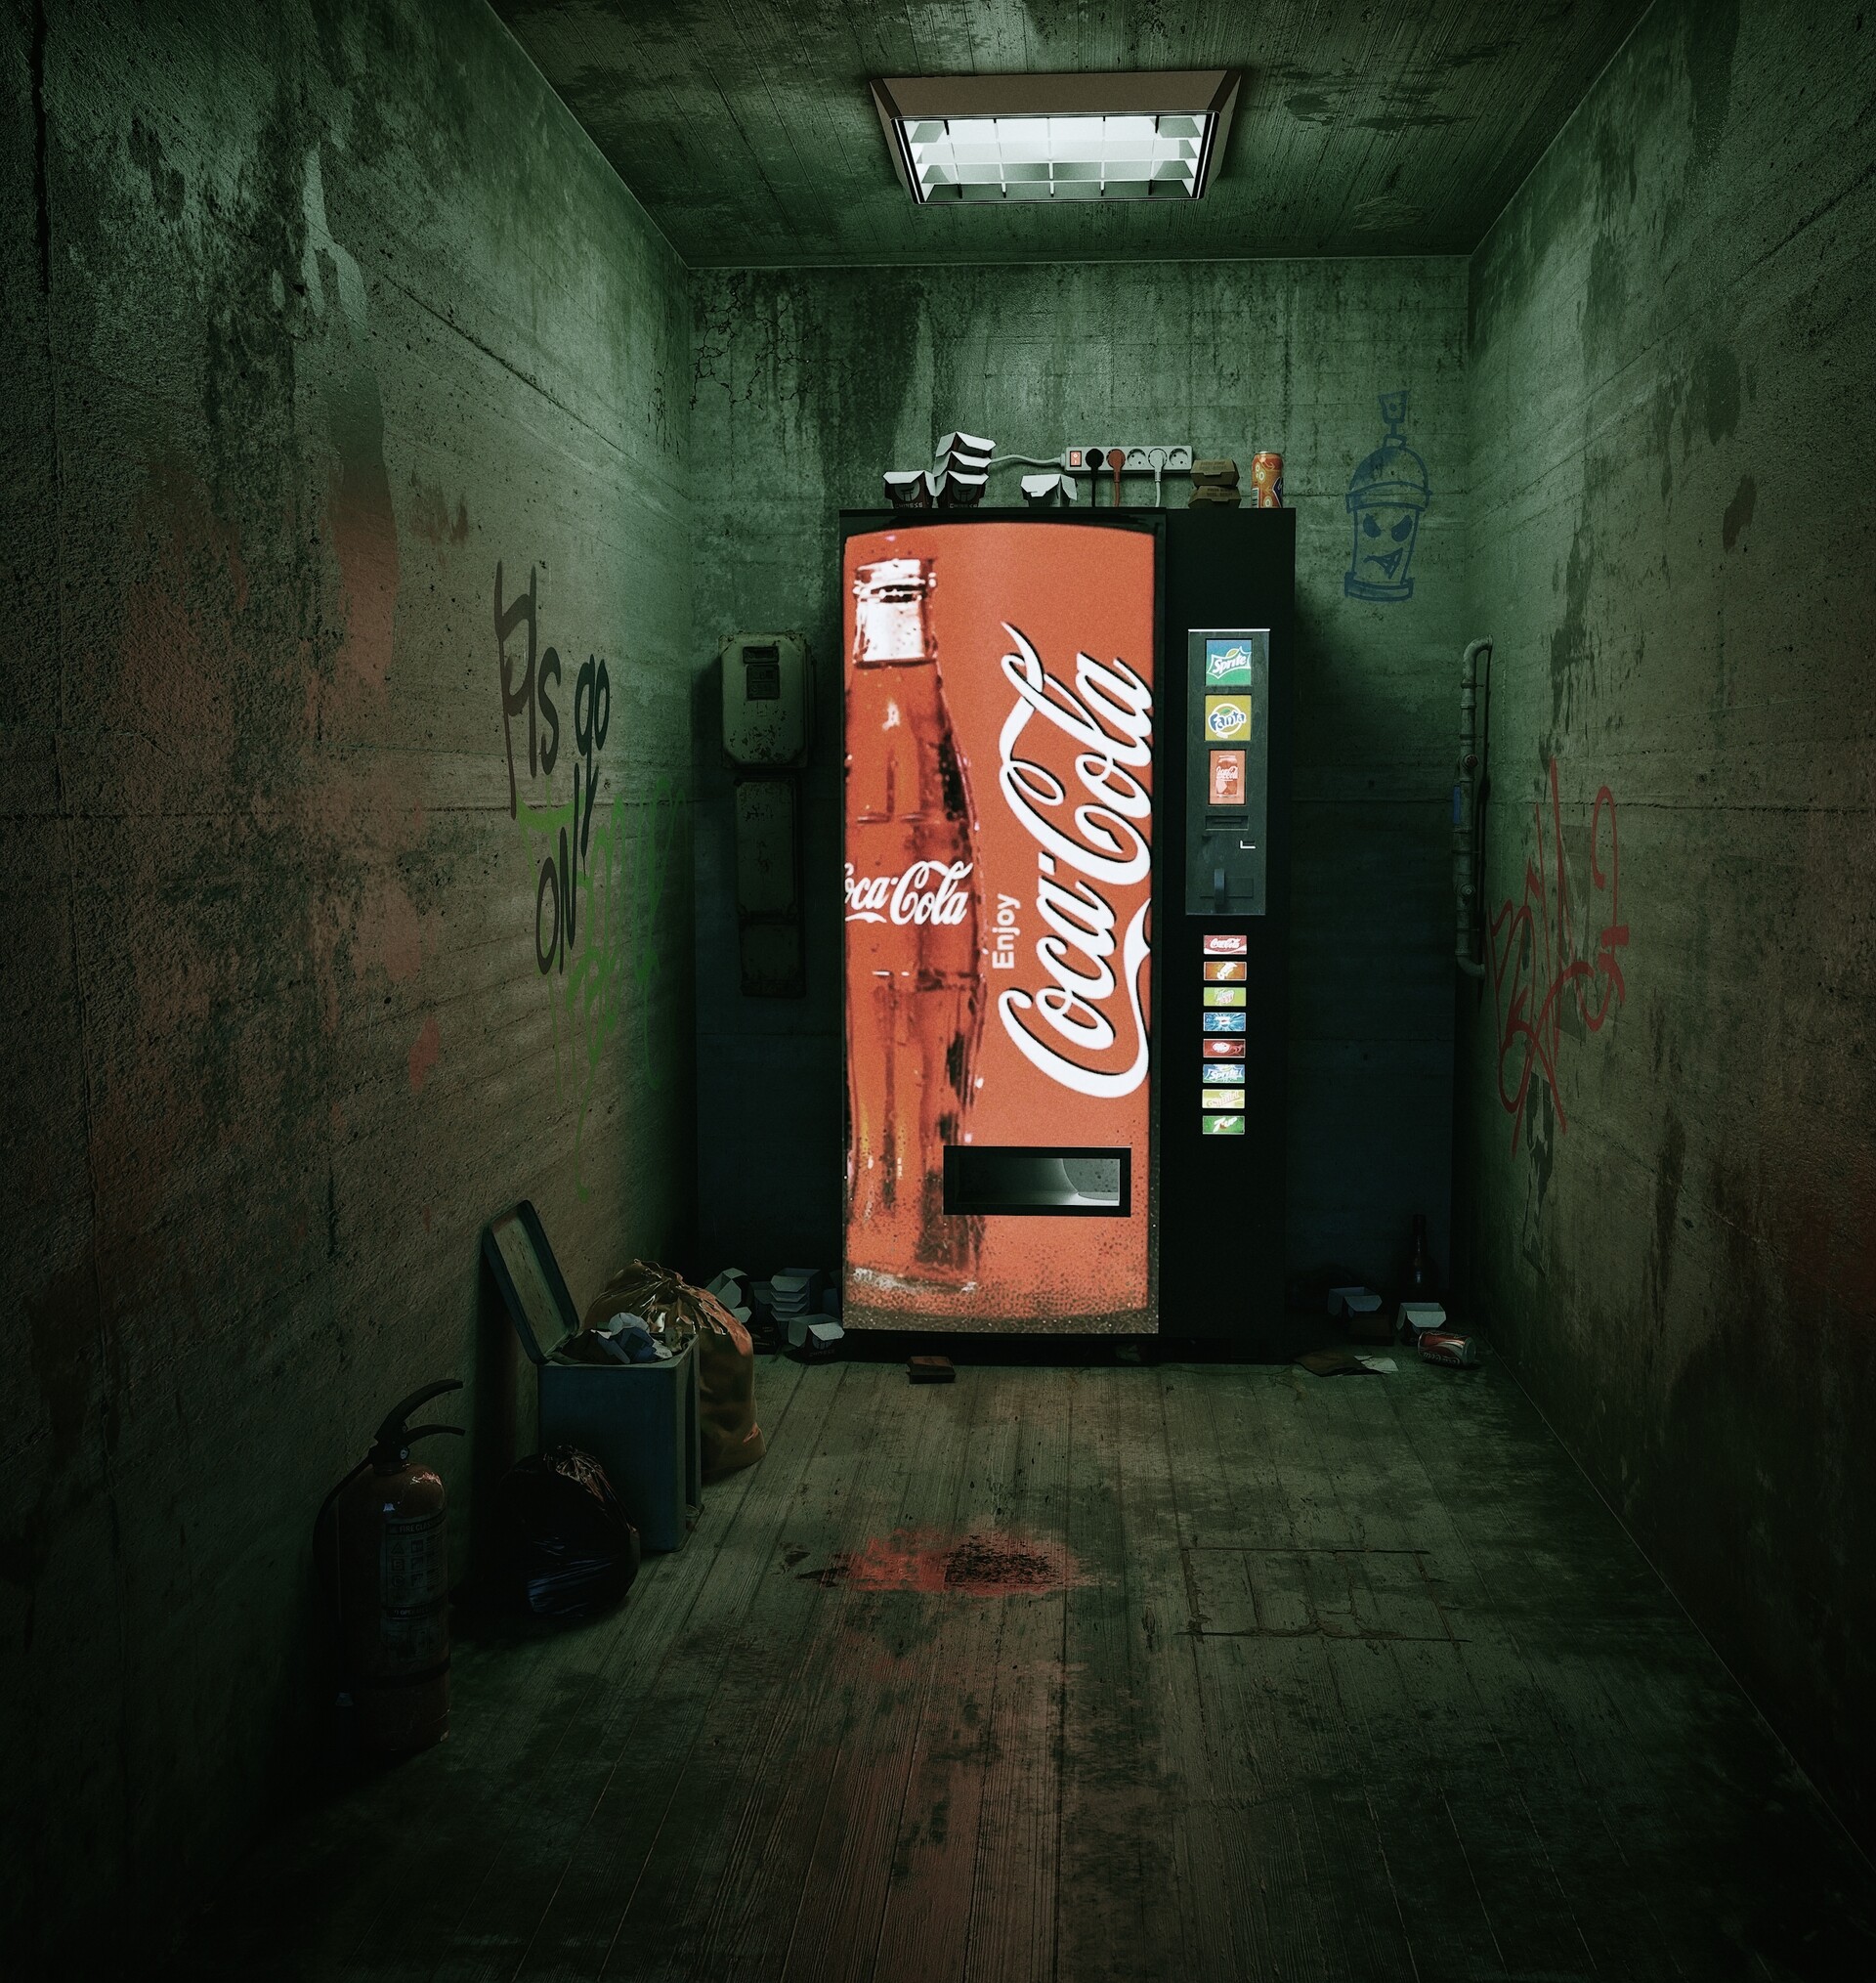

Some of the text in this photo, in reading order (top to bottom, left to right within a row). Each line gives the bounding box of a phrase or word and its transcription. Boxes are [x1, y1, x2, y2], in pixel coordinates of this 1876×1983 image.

[1212, 652, 1247, 674] Sprite
[1209, 710, 1247, 732] Fanta
[998, 621, 1152, 1098] Coca-Cola
[844, 860, 973, 926] oca-Cola
[992, 893, 1021, 970] Enjoy
